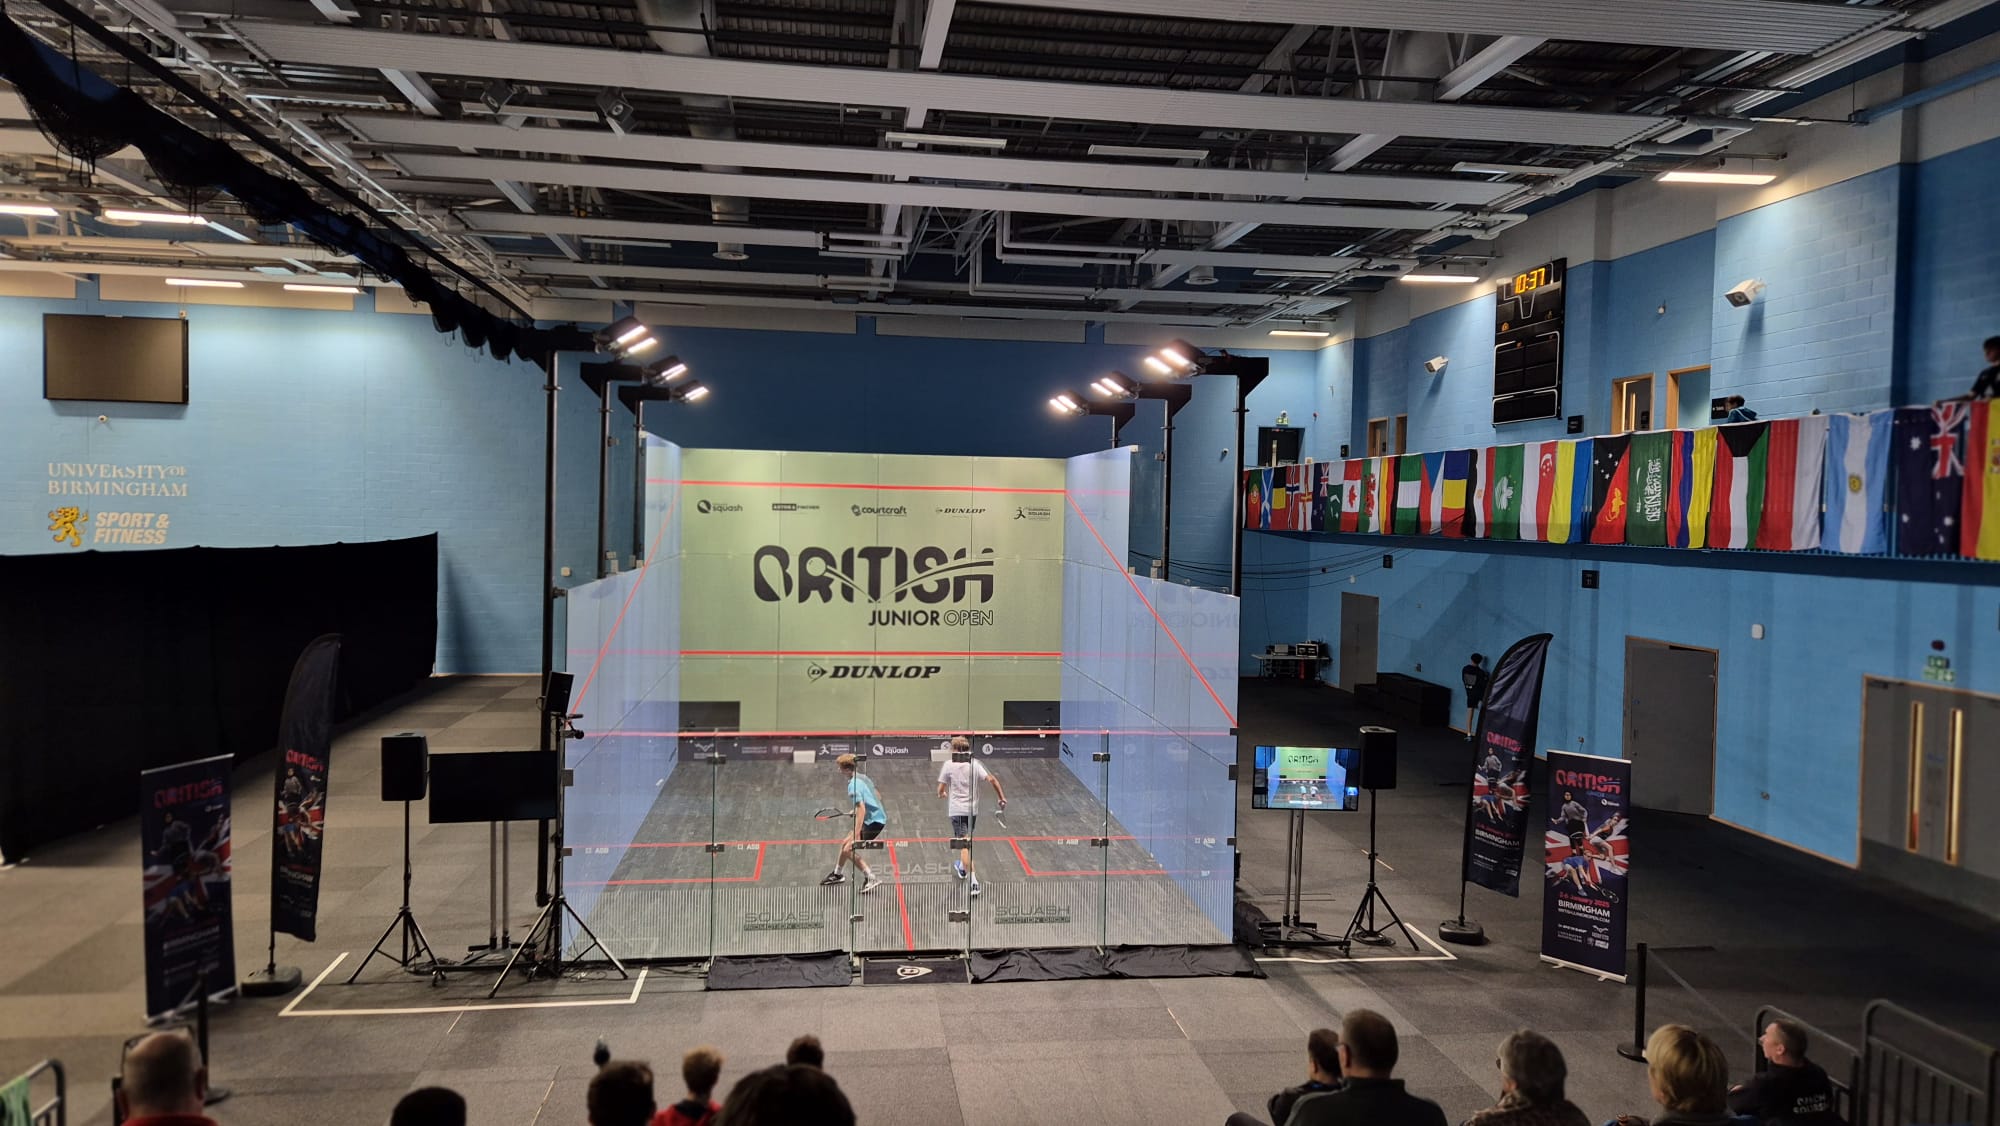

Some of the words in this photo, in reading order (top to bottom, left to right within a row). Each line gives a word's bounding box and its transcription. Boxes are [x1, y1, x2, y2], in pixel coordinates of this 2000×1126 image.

[48, 462, 167, 479] UNIVERSITY
[48, 480, 187, 497] BIRMINGHAM
[712, 503, 743, 513] squash
[861, 504, 907, 515] courtcraft
[95, 511, 155, 528] SPORT
[155, 513, 170, 529] &
[94, 528, 167, 545] FITNESS
[753, 544, 994, 604] BRITISH
[868, 609, 940, 626] JUNIOR
[943, 609, 994, 626] OPEN
[828, 665, 942, 679] DUNLOP
[744, 911, 824, 922] SQUASH
[995, 905, 1070, 917] SQUASH
[1558, 899, 1611, 918] BIRMINGHAM
